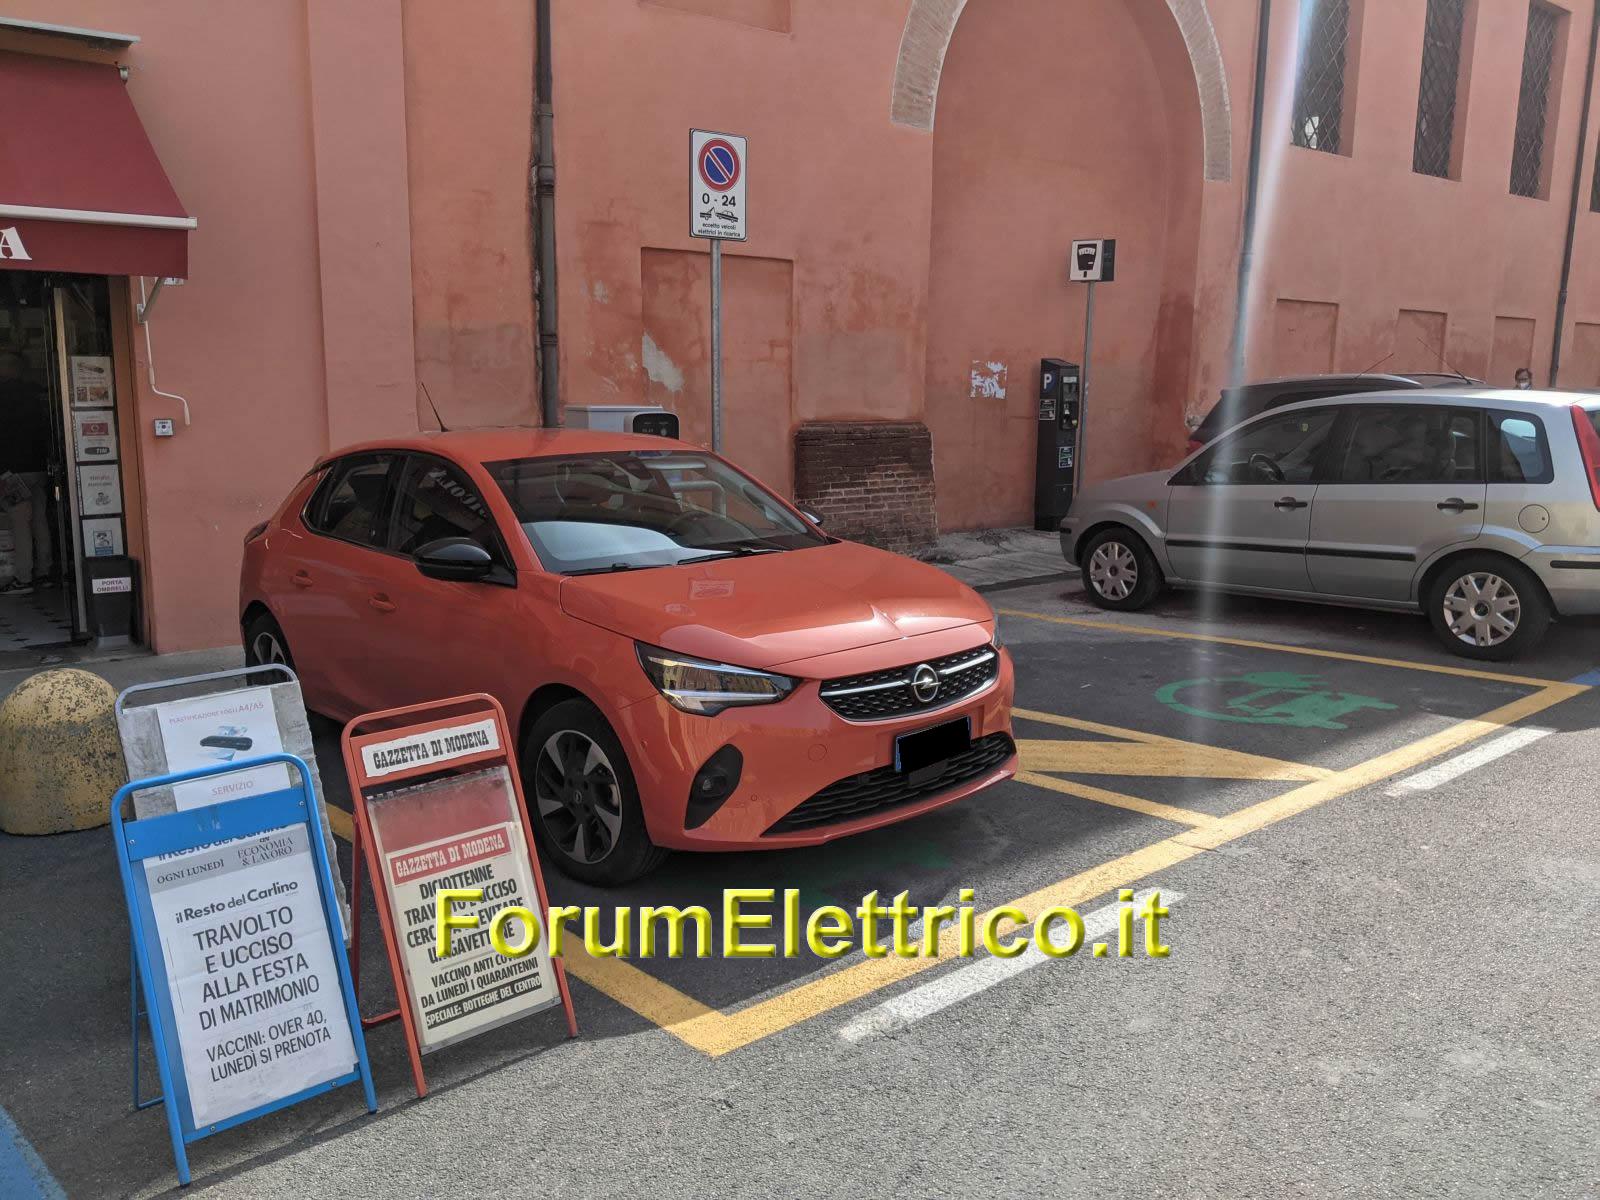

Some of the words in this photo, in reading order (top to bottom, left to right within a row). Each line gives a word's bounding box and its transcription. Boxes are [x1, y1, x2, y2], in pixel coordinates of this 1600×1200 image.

[721, 194, 737, 207] 24
[1043, 373, 1053, 390] P
[372, 742, 430, 770] GAZZETTA
[430, 739, 444, 757] DI
[444, 729, 490, 754] MODENA
[212, 781, 254, 796] SERVIZIO
[237, 837, 294, 858] ECONOMIA
[252, 846, 292, 865] LAVORO
[395, 851, 446, 878] GAZZETTA
[447, 846, 461, 863] DI
[461, 833, 506, 859] MODENA
[157, 870, 186, 884] OGNI
[187, 858, 225, 877] LUNEDÌ
[419, 864, 495, 900] DICIOTTENNE
[175, 912, 183, 924] il
[184, 902, 226, 921] Resto
[227, 894, 246, 909] del
[247, 881, 298, 902] Carlino
[193, 906, 293, 951] TRAVOLTO
[205, 955, 219, 974] E
[221, 931, 293, 969] UCCISO
[431, 964, 471, 988] VACCINO
[473, 956, 494, 974] ANTI
[203, 971, 250, 1003] ALLA
[252, 952, 309, 986] FESTA
[420, 993, 436, 1009] DA
[436, 978, 470, 1003] LUNEDÌ
[476, 956, 539, 989] QUARANTENNI
[199, 1008, 218, 1031] DI
[220, 974, 320, 1023] MATRIMONIO
[426, 1005, 462, 1027] SPECIALE:
[462, 991, 500, 1013] BOTTEGHE
[500, 985, 514, 999] DEL
[514, 975, 541, 993] CENTRO
[206, 1030, 266, 1062] VACCINI:
[268, 1016, 304, 1041] OVER
[306, 1009, 328, 1026] 40,
[210, 1050, 258, 1082] LUNEDÌ
[260, 1047, 272, 1064] SI
[274, 1026, 331, 1059] PRENOTA
